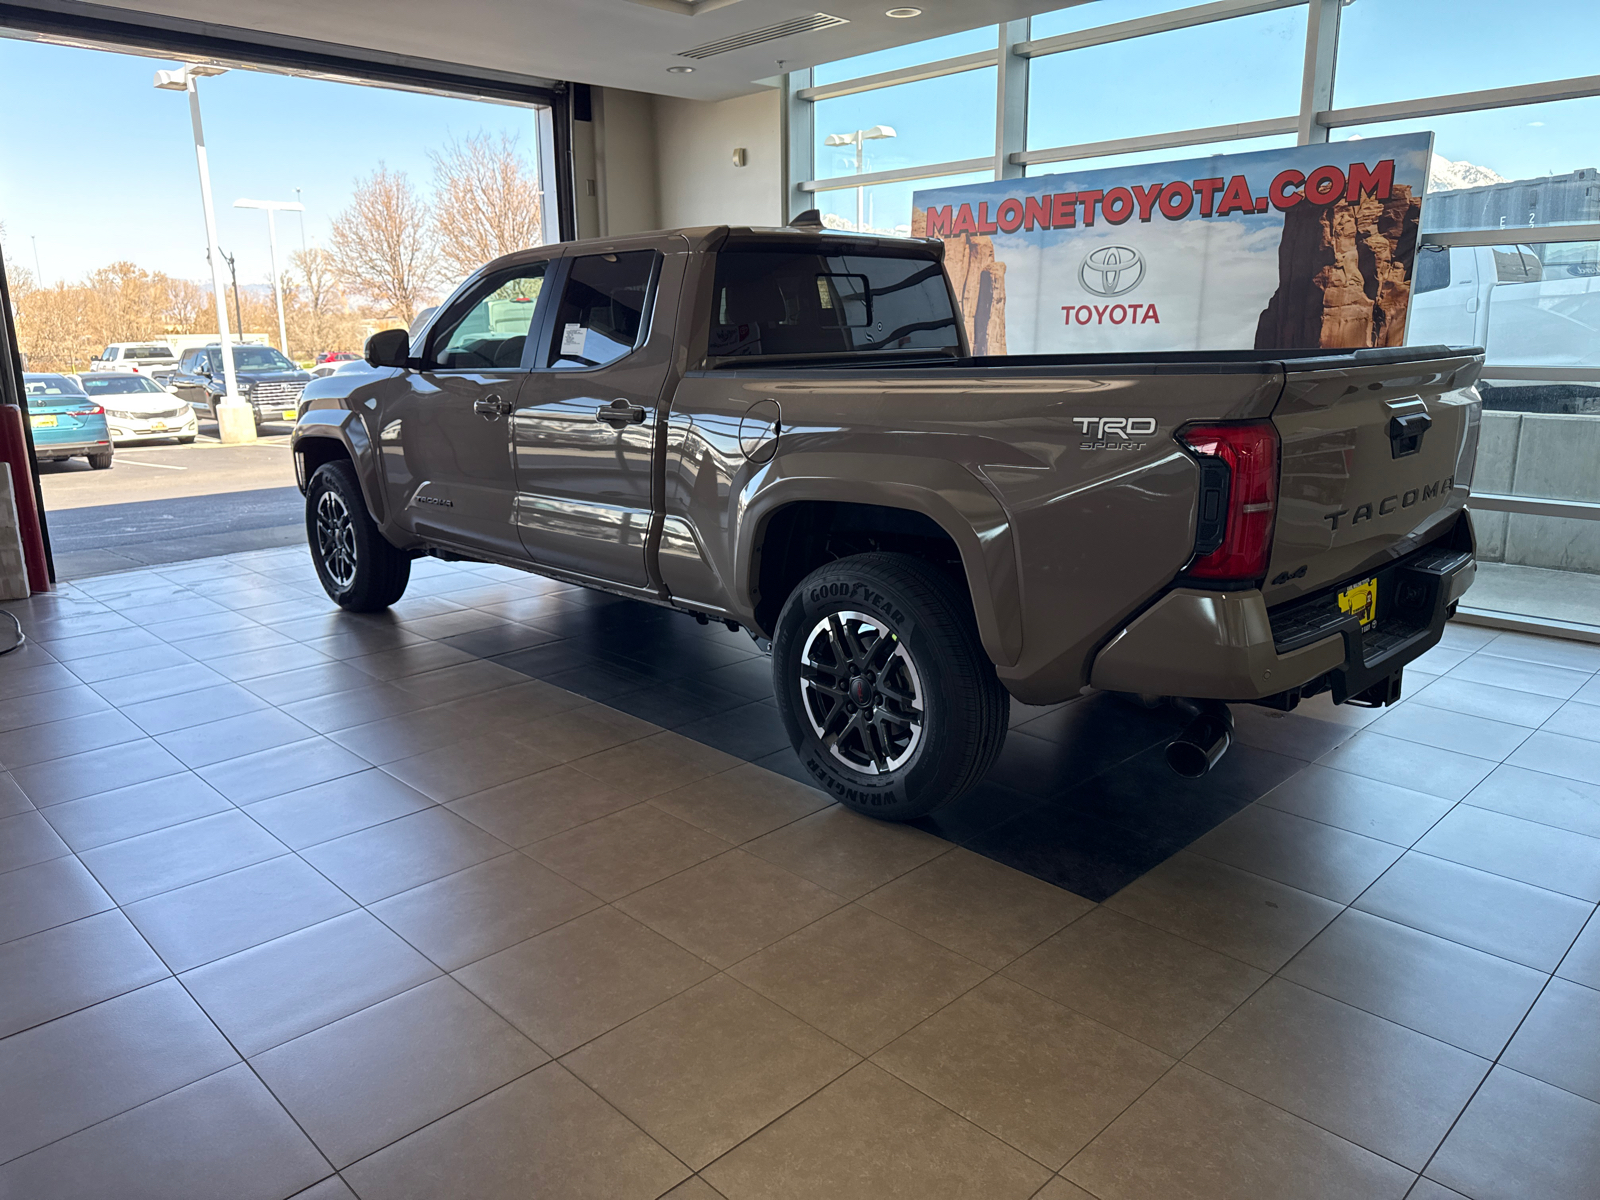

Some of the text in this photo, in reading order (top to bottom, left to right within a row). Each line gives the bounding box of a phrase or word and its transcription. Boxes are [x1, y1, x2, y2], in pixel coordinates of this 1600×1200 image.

[926, 159, 1395, 238] MALONETOYOTA.COM
[1061, 303, 1161, 326] TOYOTA
[1072, 416, 1158, 440] TRD
[1079, 441, 1147, 451] SPORT
[1323, 474, 1455, 532] TACOMA
[807, 756, 899, 807] WRANGLER
